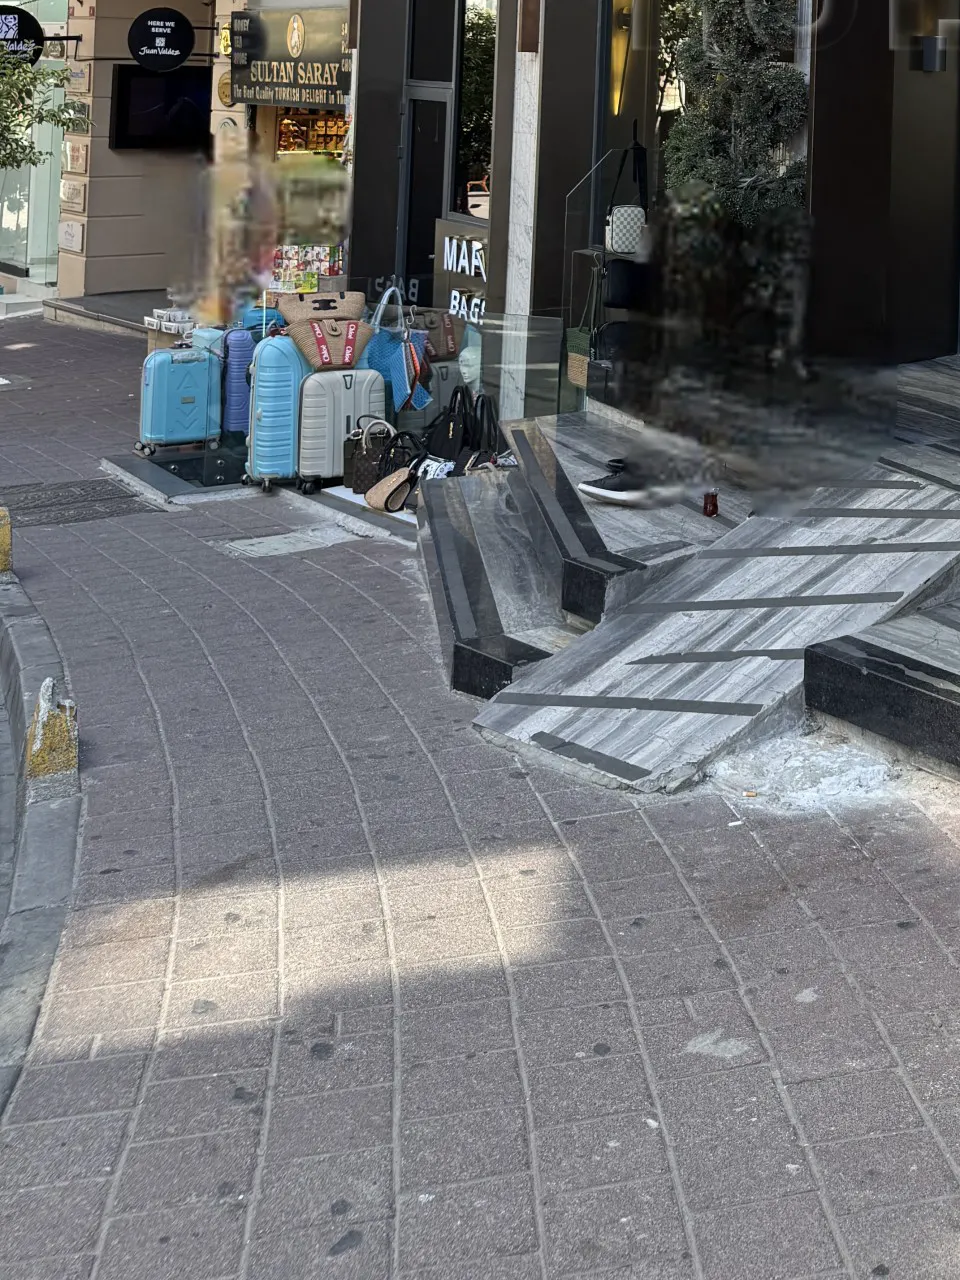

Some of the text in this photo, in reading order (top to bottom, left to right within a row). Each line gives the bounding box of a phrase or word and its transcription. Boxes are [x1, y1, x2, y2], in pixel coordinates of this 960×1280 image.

[139, 46, 181, 56] Juan Valdez
[250, 61, 340, 86] SULTAN SARAY
[274, 87, 300, 102] TURKISH
[301, 88, 327, 103] DELIGHT
